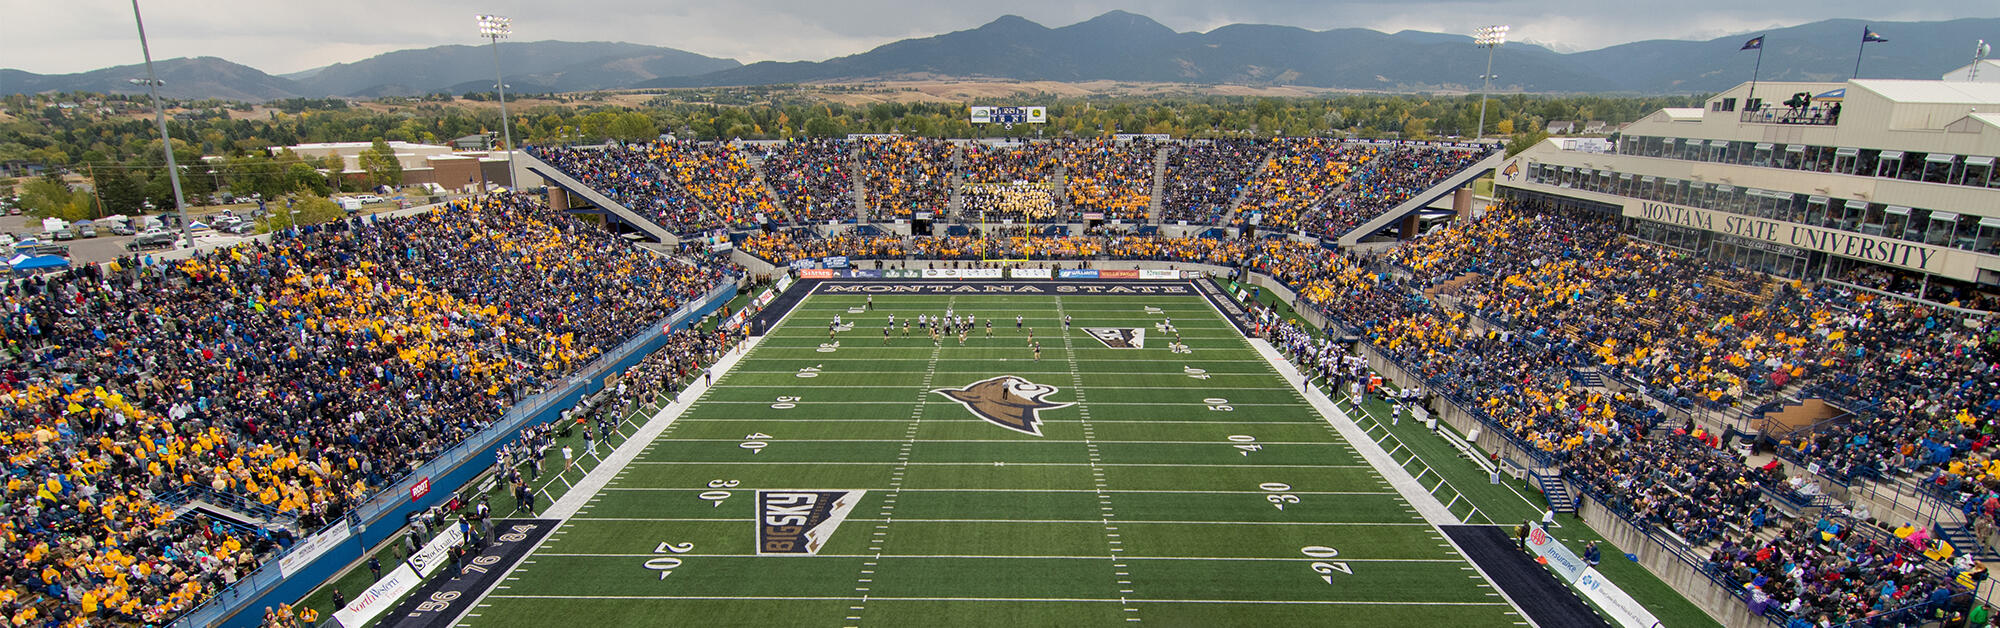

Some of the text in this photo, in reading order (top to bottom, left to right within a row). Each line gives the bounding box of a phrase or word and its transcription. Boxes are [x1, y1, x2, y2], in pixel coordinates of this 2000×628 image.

[1640, 202, 1713, 230] MONTANA
[1724, 215, 1780, 242] STATE
[1790, 226, 1937, 270] UNIVERSITY
[1056, 285, 1188, 293] STATE
[770, 395, 801, 409] 50
[1203, 398, 1234, 412] 50
[739, 432, 773, 449] 40
[1228, 435, 1263, 452] 40
[412, 480, 428, 497] ROOT
[699, 479, 740, 500] 30
[1259, 482, 1300, 504] 30
[1531, 529, 1545, 545] AAA
[421, 537, 453, 563] Stockman
[643, 541, 694, 570] 20
[1301, 546, 1354, 575] 20
[1547, 547, 1577, 573] Insurance
[349, 576, 399, 613] NorthWestern
